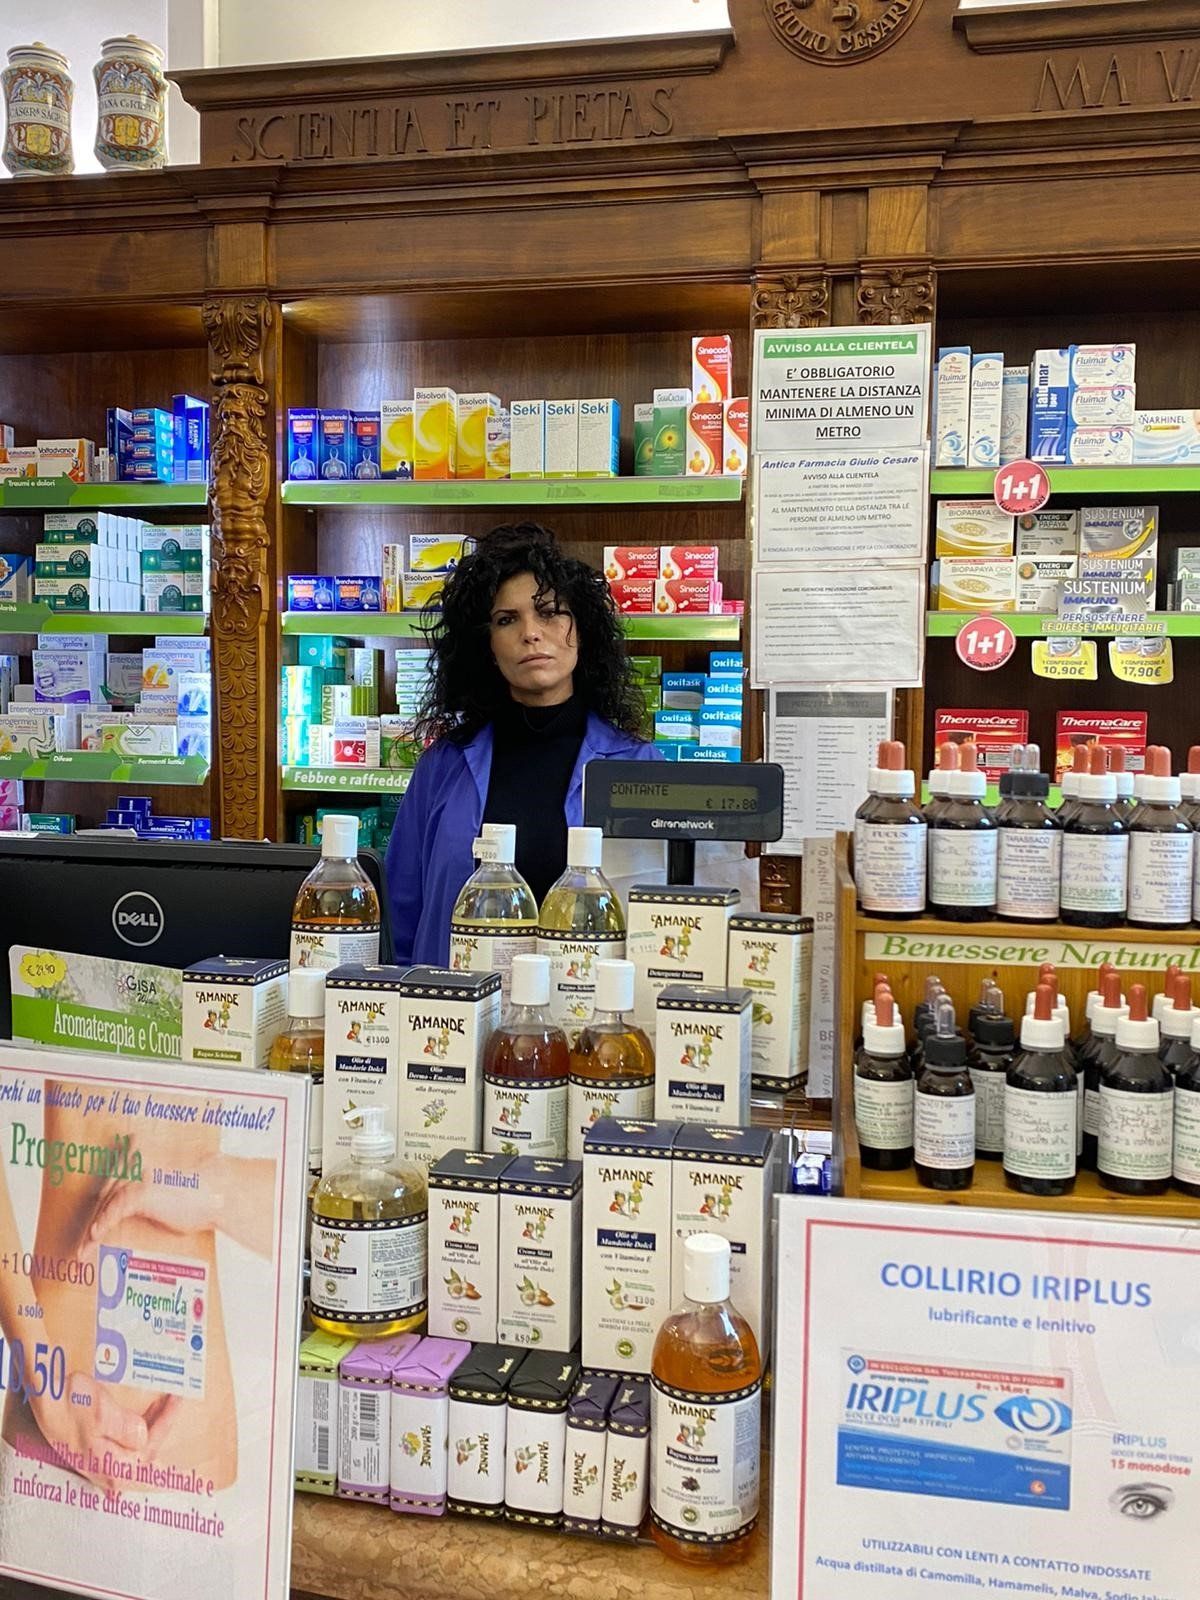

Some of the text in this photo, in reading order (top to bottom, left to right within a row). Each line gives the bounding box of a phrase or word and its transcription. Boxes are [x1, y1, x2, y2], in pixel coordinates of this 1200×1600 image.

[232, 86, 679, 162] SCIENTIA ET PIETAS
[767, 340, 914, 354] AVVISO ALLA CLIENTELA
[1076, 356, 1107, 366] Fluimar
[800, 365, 895, 379] OBBLIGATORIO
[939, 374, 967, 383] Fluimar
[973, 380, 1000, 388] Fluimar
[416, 392, 446, 400] Bisolvon
[760, 384, 922, 400] MANTENERE LA DISTANZA
[459, 398, 488, 406] Bisolvon
[1076, 395, 1107, 405] Fluimar
[382, 405, 412, 413] Bisolvon
[512, 403, 541, 416] Seki
[547, 403, 575, 416] Seki
[581, 402, 609, 415] Seki
[765, 405, 914, 419] MINIMA DI ALMENO UN
[692, 412, 722, 421] Sinecod
[816, 426, 861, 438] METRO
[1073, 436, 1105, 446] Fluimar
[762, 455, 919, 470] Antica Farmacia Giulio Cesare
[828, 472, 845, 480] ALLA
[846, 471, 879, 479] CLIENTELA
[1001, 473, 1041, 501] 1+1
[1084, 508, 1145, 520] SUSTENIUM
[412, 536, 439, 544] Bisolvon
[628, 552, 658, 560] Sinecod
[684, 552, 715, 560] Sinecod
[1082, 559, 1143, 570] SUSTENIUM
[622, 585, 652, 593] Sinecod
[679, 585, 710, 593] Sinecod
[1063, 580, 1146, 595] SUSTENIUM
[1063, 596, 1118, 605] IMMUNO
[1062, 613, 1145, 621] PER SOSTENERE
[1092, 622, 1163, 632] IMMUNITARIE
[966, 630, 1006, 655] 1+1
[939, 714, 1020, 725] ThermaCare
[1061, 716, 1143, 728] ThermaCare
[294, 771, 336, 784] Febbre
[340, 775, 347, 784] e
[611, 783, 669, 796] CONTANTE
[651, 817, 714, 830] ditronetwork
[118, 911, 158, 927] DELL
[882, 934, 1050, 963] Benessere
[53, 1003, 137, 1055] Aromaterapia
[138, 1028, 146, 1051] e
[27, 1083, 276, 1132] un alleato per il tuo benessere intestinale?
[10, 1121, 144, 1188] Progermila
[153, 1167, 200, 1190] 10 miliardi
[22, 1252, 96, 1287] OMAGGIO
[880, 1261, 1153, 1309] COLLIRIO IRIPLUS
[126, 1285, 188, 1321] Progermila
[25, 1303, 44, 1319] solo
[928, 1306, 1096, 1336] lubrificante e lenitivo
[71, 1391, 92, 1407] euro
[846, 1381, 988, 1424] IRIPLUS
[1112, 1433, 1168, 1449] IRIPLUS
[1110, 1458, 1191, 1476] 15 monodose
[87, 1452, 100, 1474] la
[102, 1452, 133, 1481] flora
[136, 1458, 203, 1496] intestinale
[205, 1477, 214, 1497] e
[13, 1471, 225, 1539] rinforza le tue difese immunitarie
[862, 1537, 1152, 1581] UTILIZZABILI CON LENTI A CONTATTO INDOSSATE
[815, 1554, 851, 1571] Acqua
[854, 1557, 904, 1578] distillata
[906, 1563, 918, 1579] di
[919, 1566, 986, 1588] Camomilla,
[988, 1573, 1058, 1597] Hamamelis,
